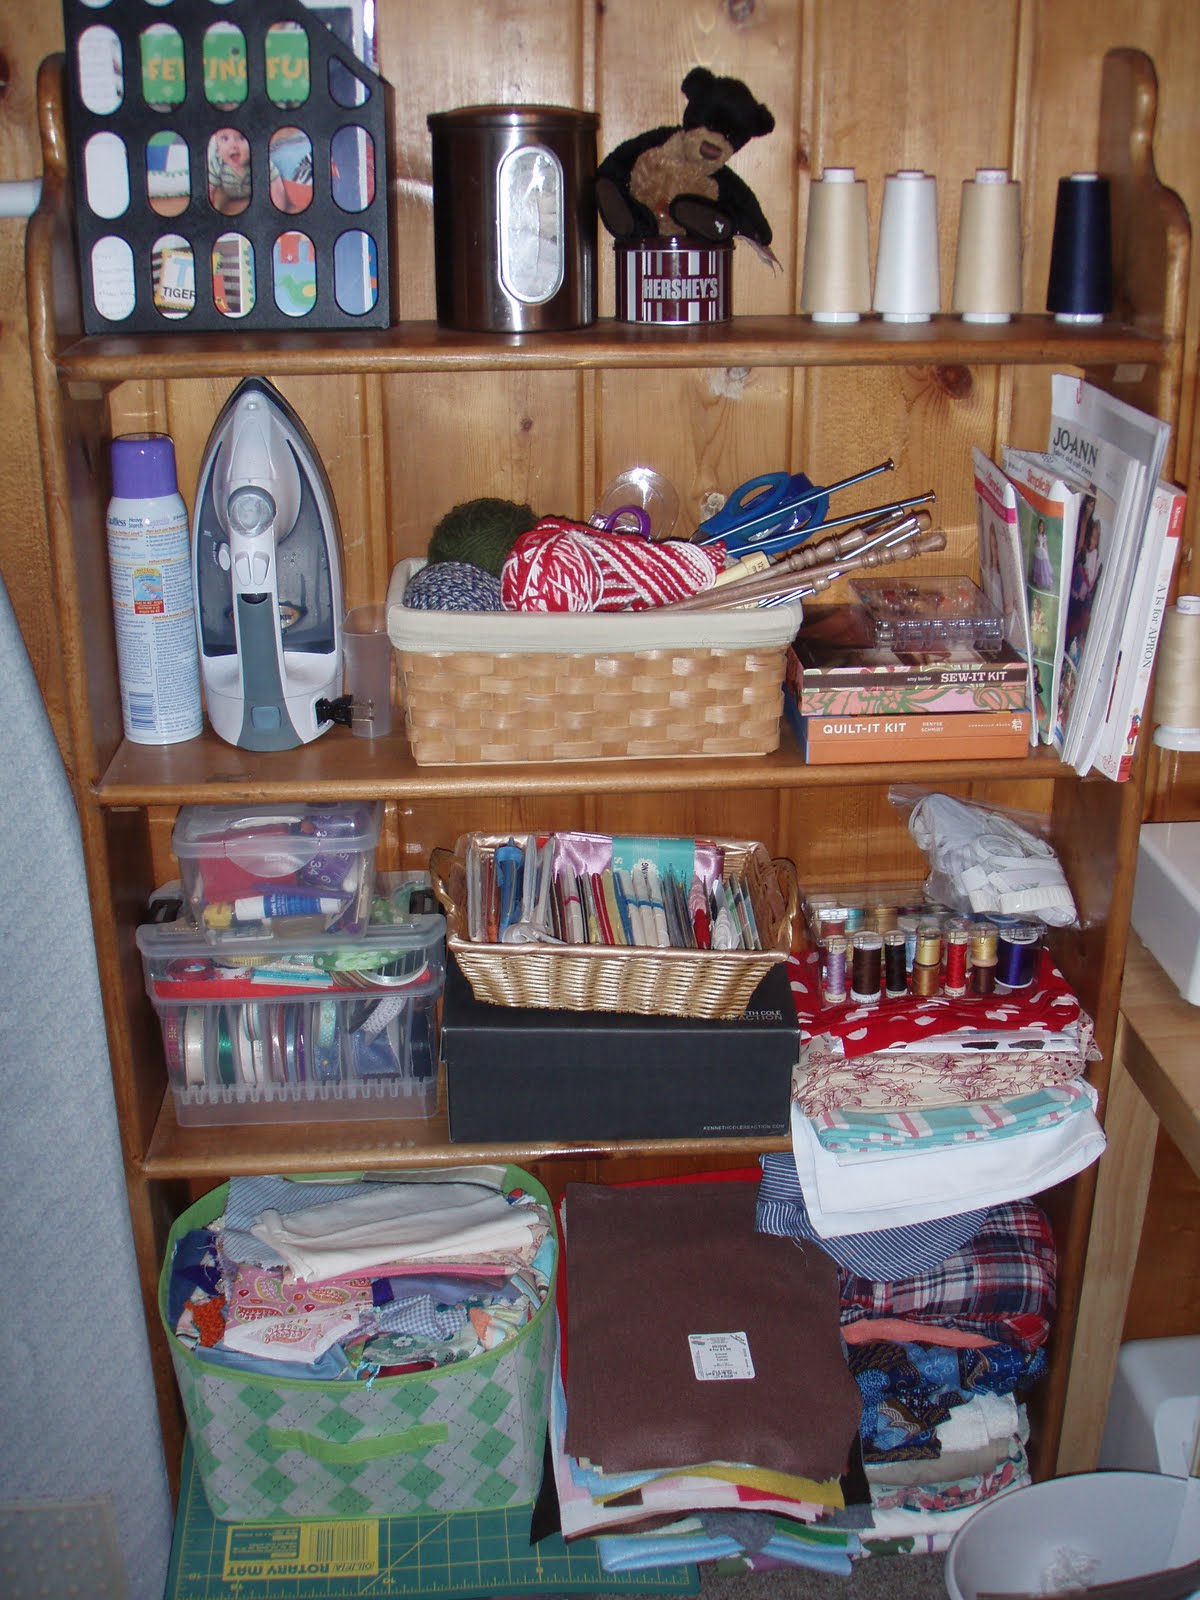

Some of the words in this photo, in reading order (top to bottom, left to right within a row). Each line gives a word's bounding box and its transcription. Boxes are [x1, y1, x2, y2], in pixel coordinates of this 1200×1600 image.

[643, 278, 718, 299] HERSHEY'S
[1142, 627, 1158, 669] APRON
[940, 671, 987, 683] SEW-IT
[988, 671, 1008, 681] KIT
[823, 723, 880, 735] QUILT-IT
[884, 722, 907, 733] KIT
[226, 1565, 264, 1577] MAT
[266, 1562, 330, 1575] ROTARY
